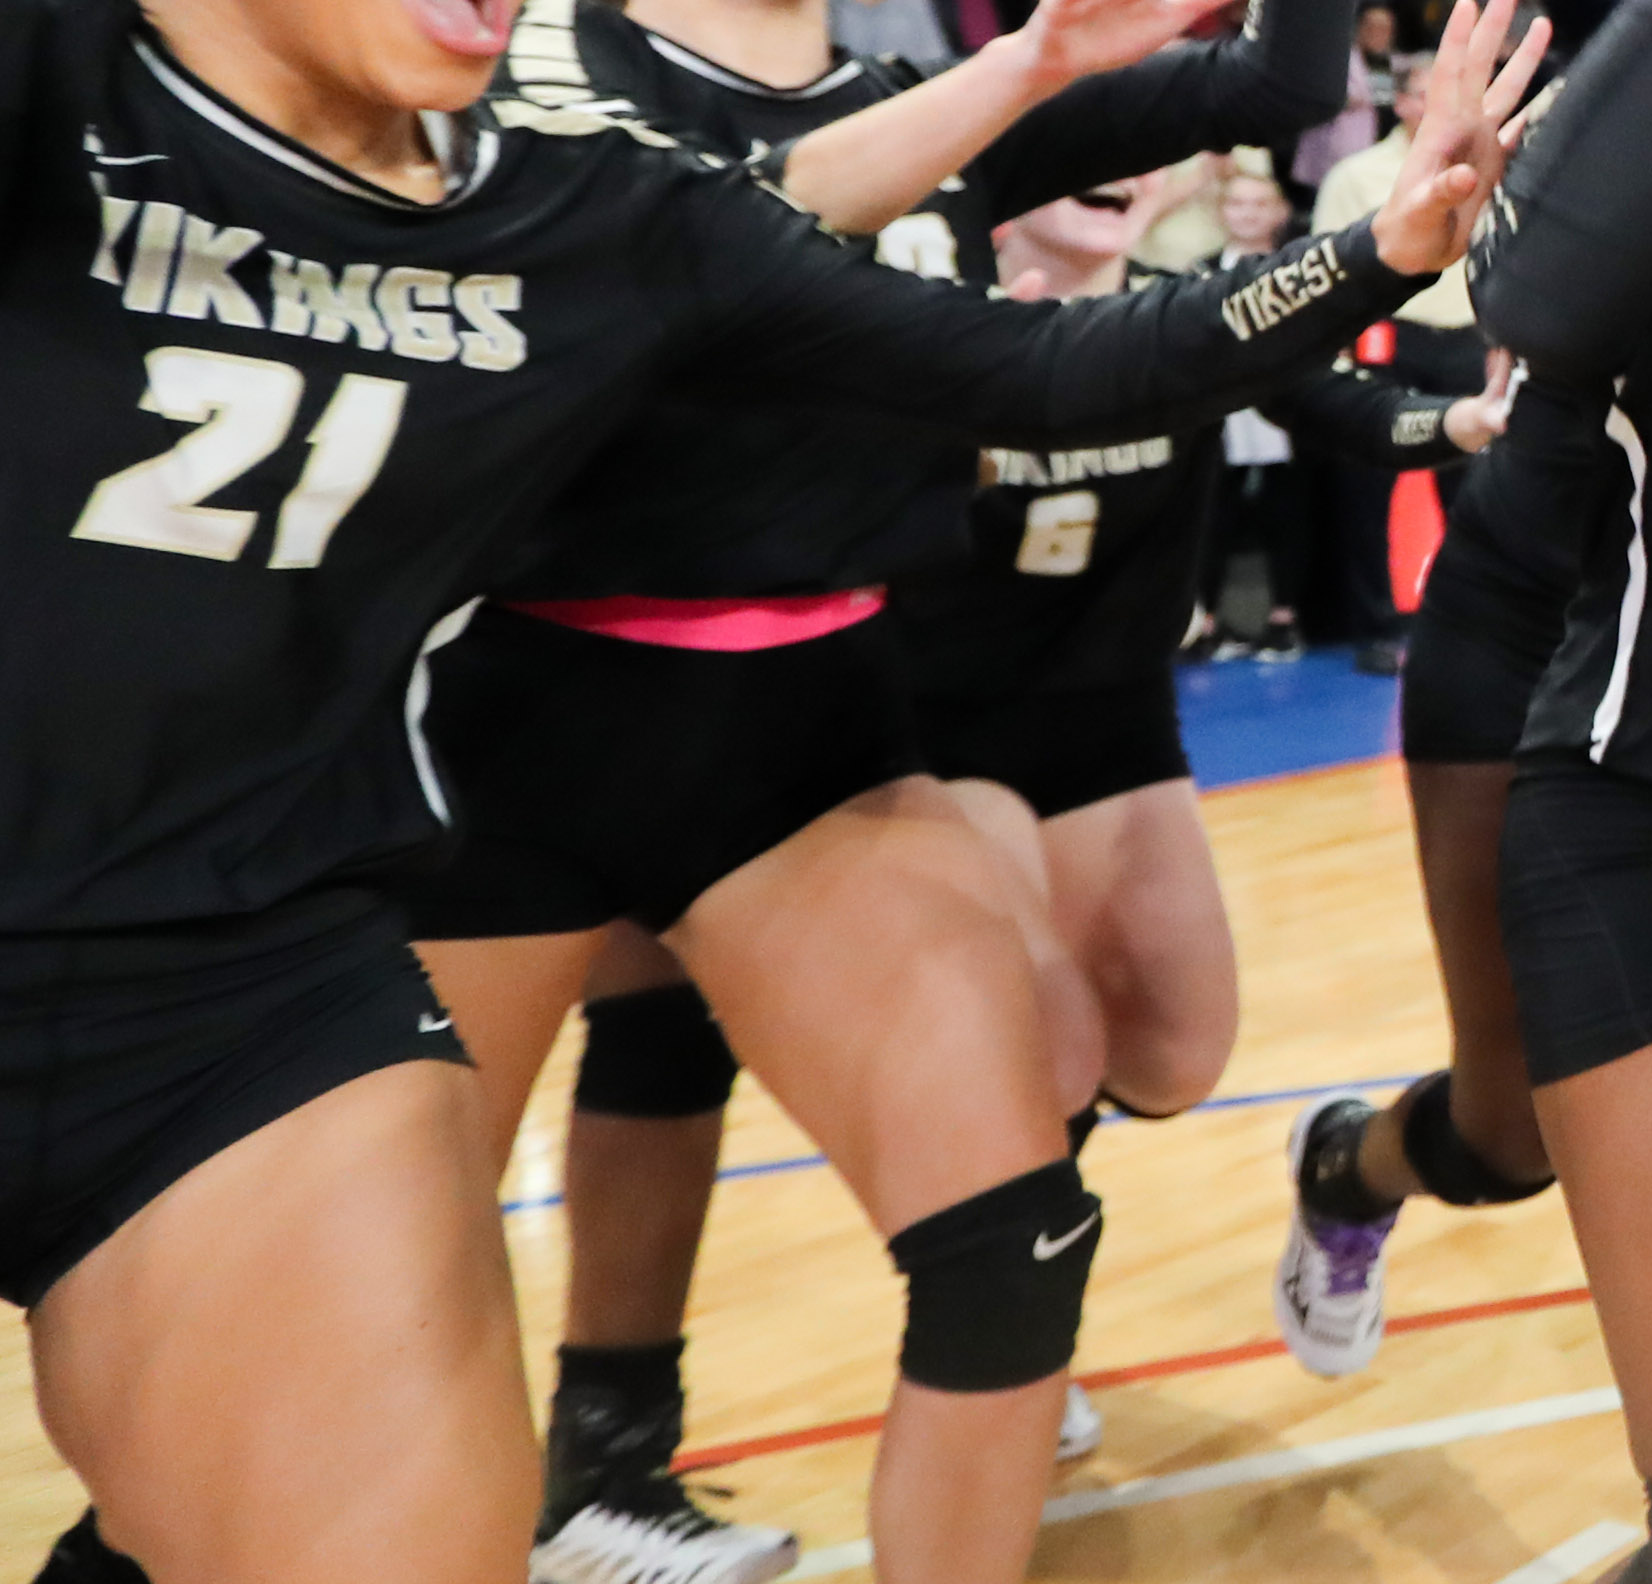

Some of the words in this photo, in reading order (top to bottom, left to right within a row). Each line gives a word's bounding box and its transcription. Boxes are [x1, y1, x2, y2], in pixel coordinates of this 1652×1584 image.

[1222, 237, 1347, 341] VIKES!
[71, 346, 408, 570] 21
[1015, 489, 1100, 576] 6
